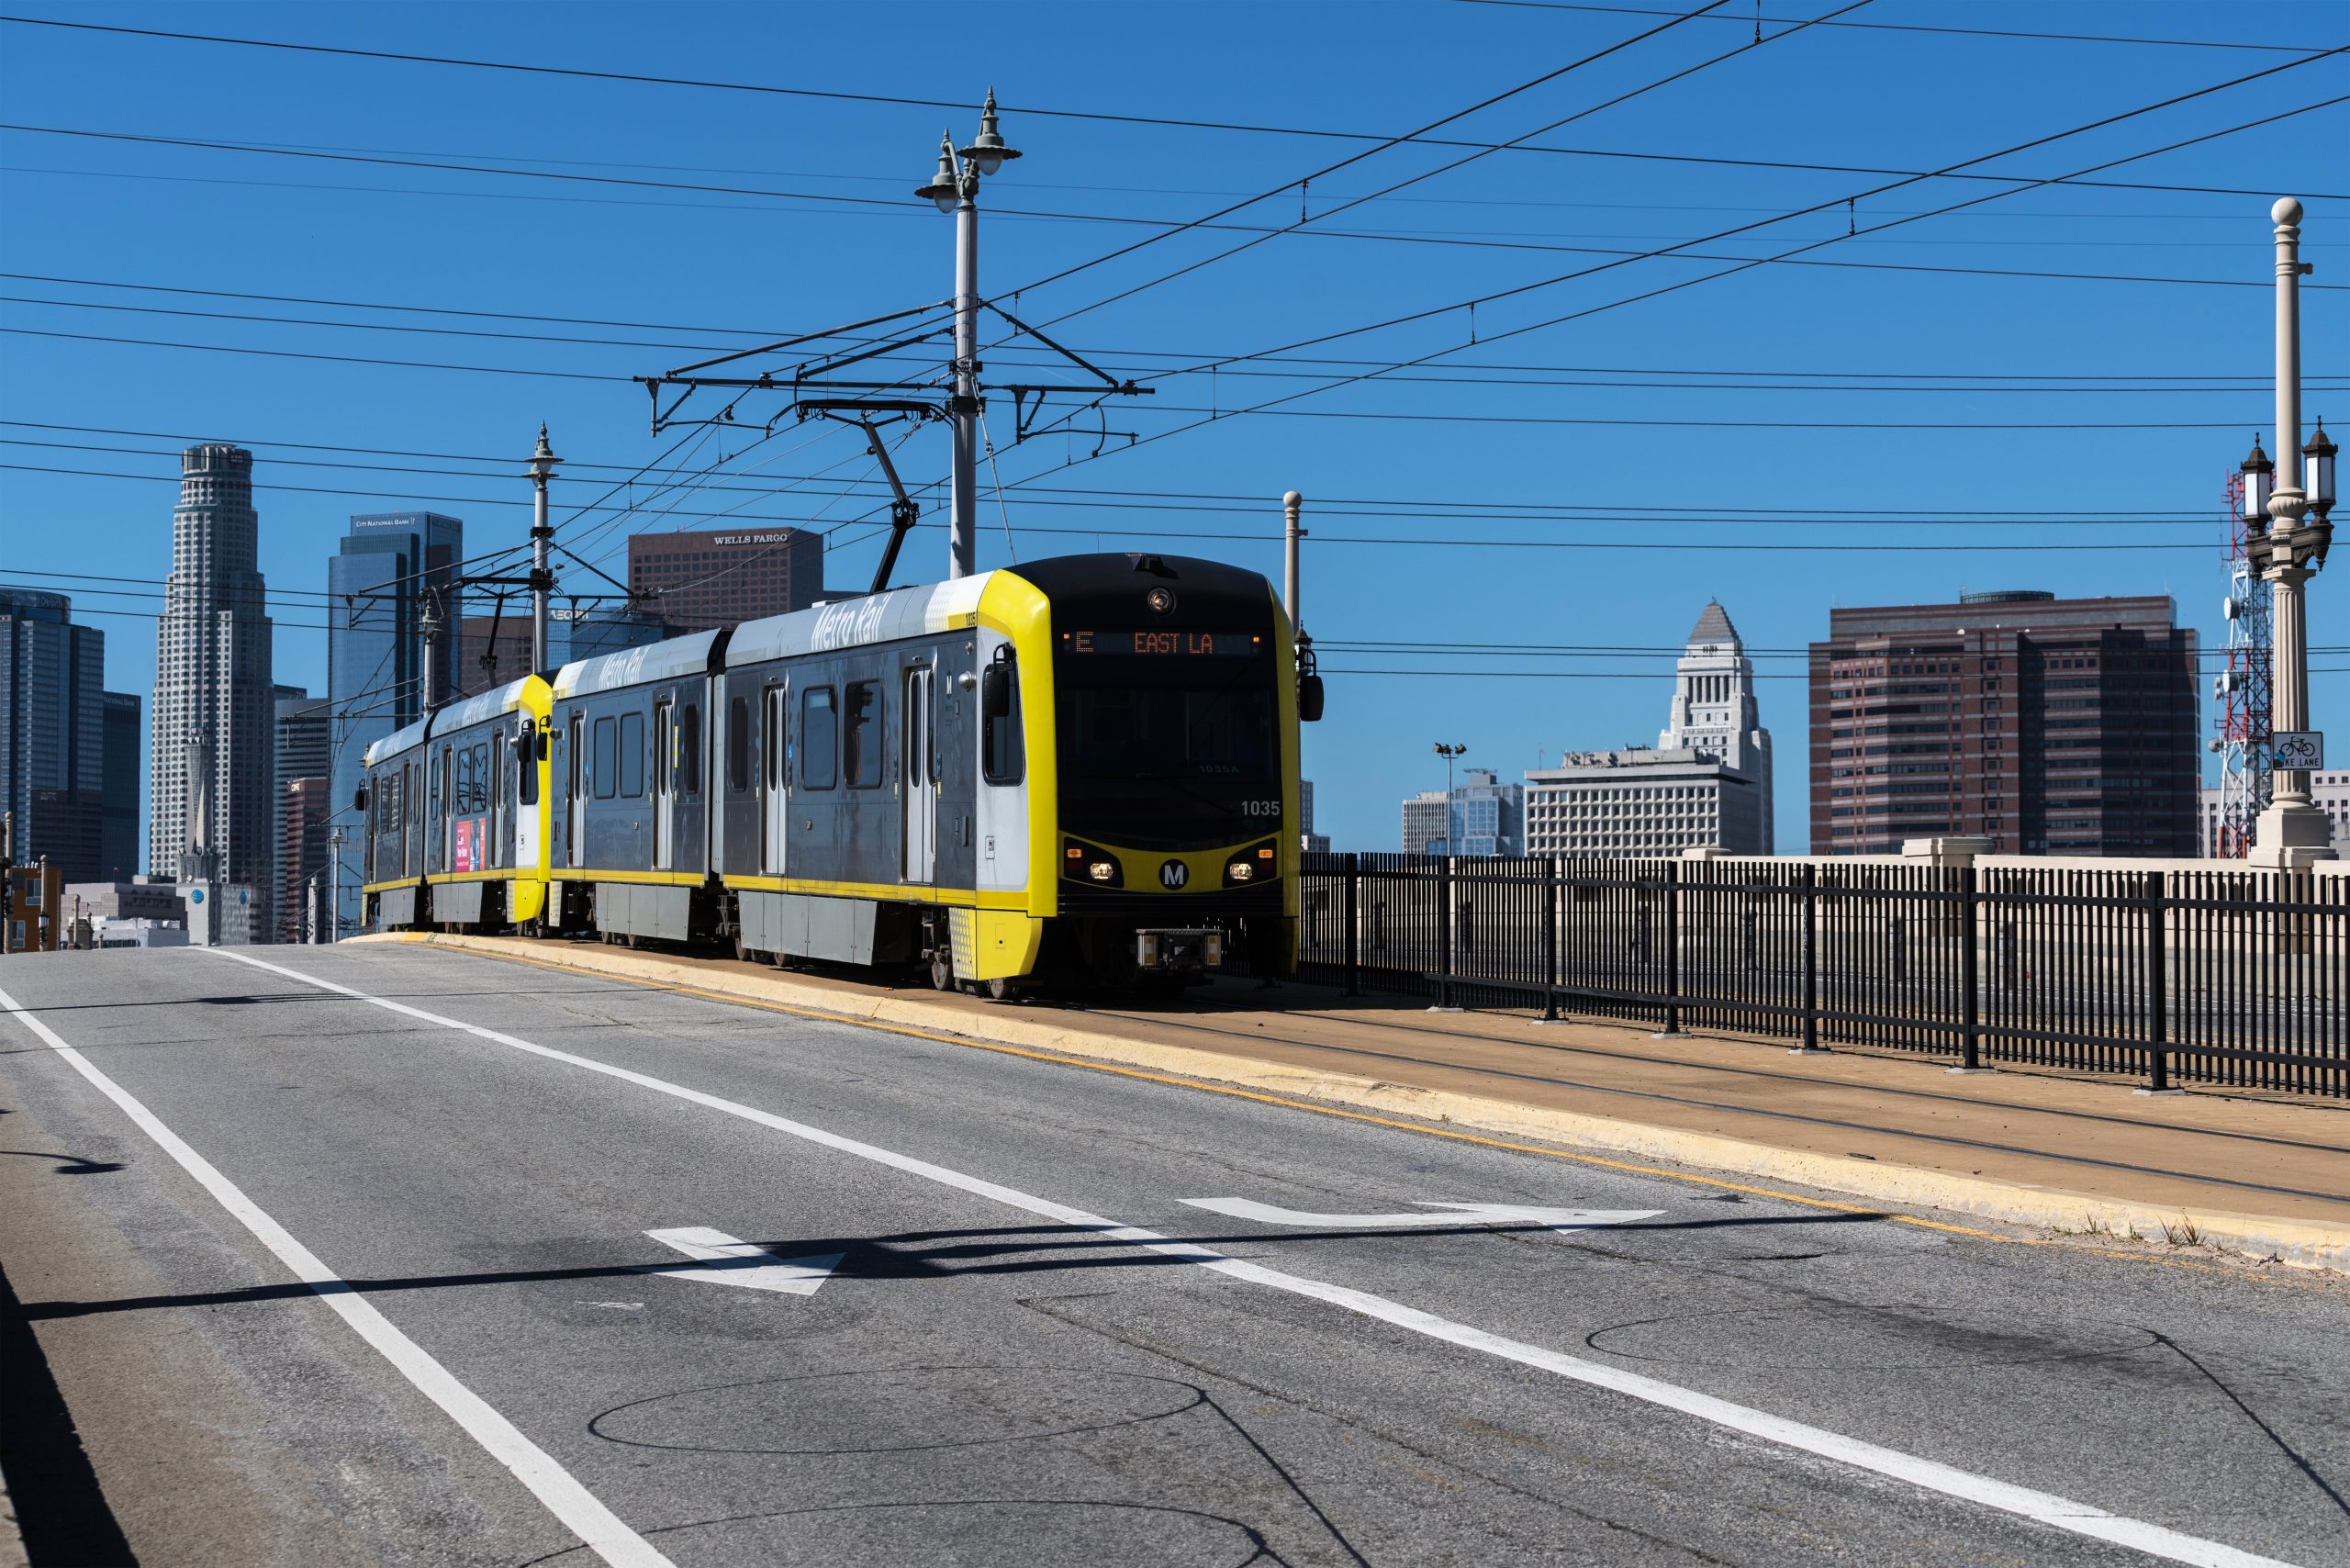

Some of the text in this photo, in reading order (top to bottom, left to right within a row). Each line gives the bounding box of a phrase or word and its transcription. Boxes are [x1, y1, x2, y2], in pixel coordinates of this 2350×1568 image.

[714, 533, 788, 544] WELLS FARGO
[811, 591, 895, 651] Metro Rail
[1076, 631, 1093, 653] E
[1135, 632, 1213, 654] EAST LA
[599, 644, 653, 691] Metro Rail
[1199, 765, 1240, 773] 1035A
[1241, 801, 1281, 815] 1035
[1164, 865, 1184, 885] M
